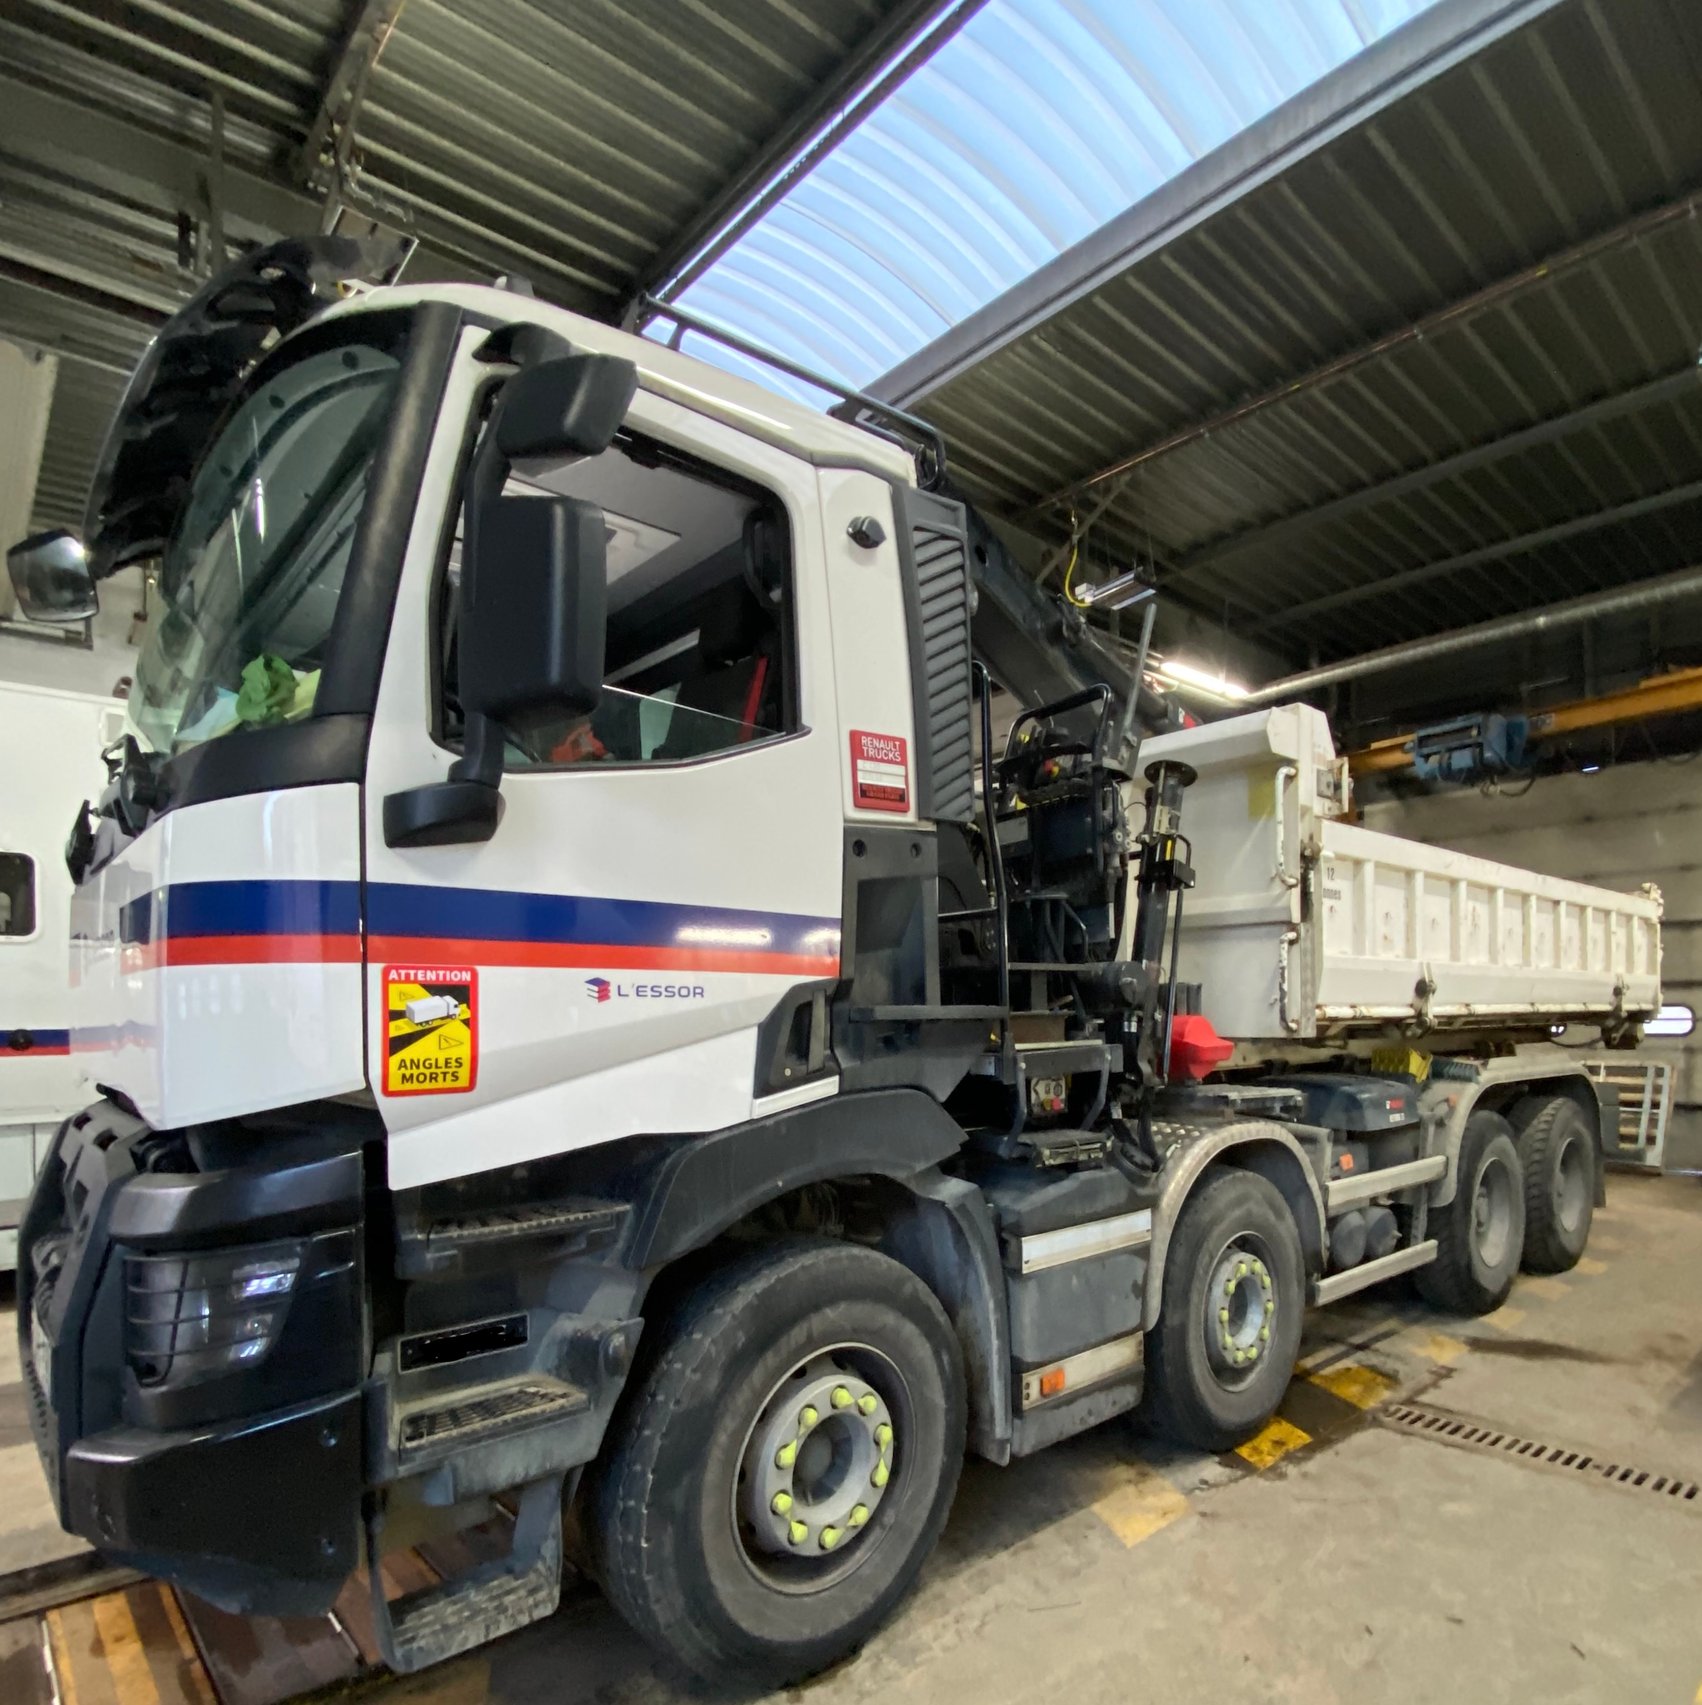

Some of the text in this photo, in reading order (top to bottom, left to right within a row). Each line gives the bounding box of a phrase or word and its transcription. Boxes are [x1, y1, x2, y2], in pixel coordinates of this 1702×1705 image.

[861, 736, 900, 751] RENAULT
[862, 747, 901, 762] TRUCKS
[388, 969, 472, 981] ATTENTION
[617, 983, 705, 998] L'ESSOR
[397, 1057, 464, 1071] ANGLES
[401, 1071, 460, 1085] MORTS
